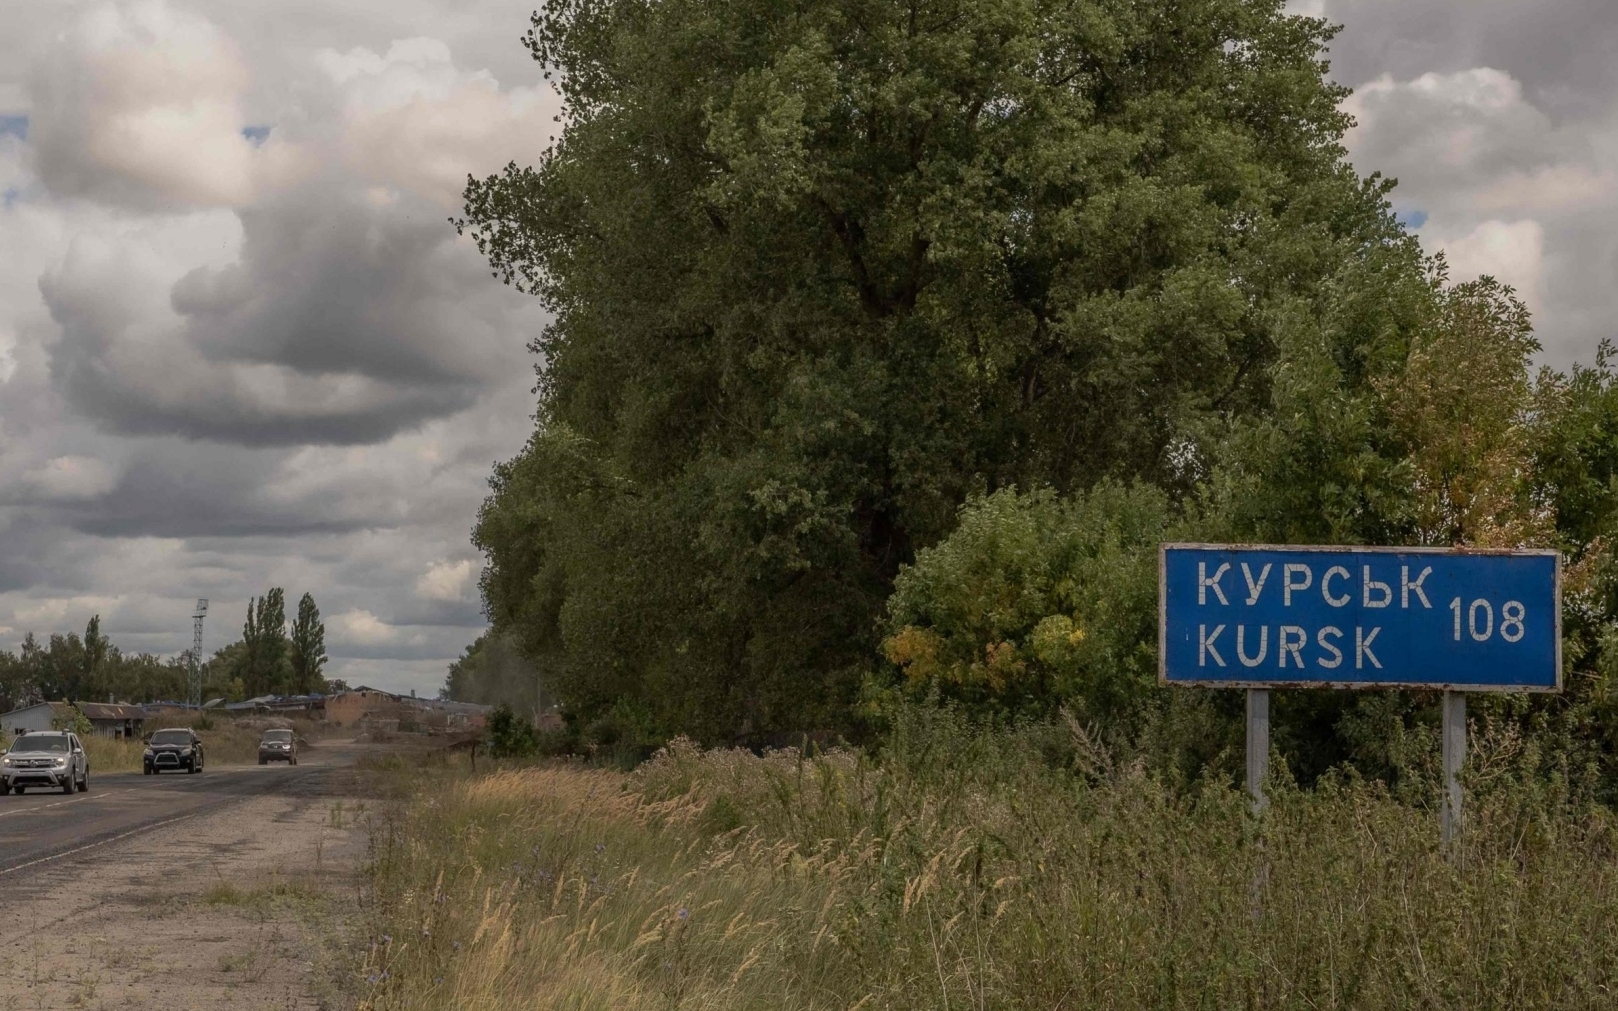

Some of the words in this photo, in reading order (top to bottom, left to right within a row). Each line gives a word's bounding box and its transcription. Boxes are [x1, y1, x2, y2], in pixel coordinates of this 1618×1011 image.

[1198, 561, 1433, 609] КУРСЬК
[1449, 596, 1526, 643] 108
[1198, 624, 1383, 669] KURSK
